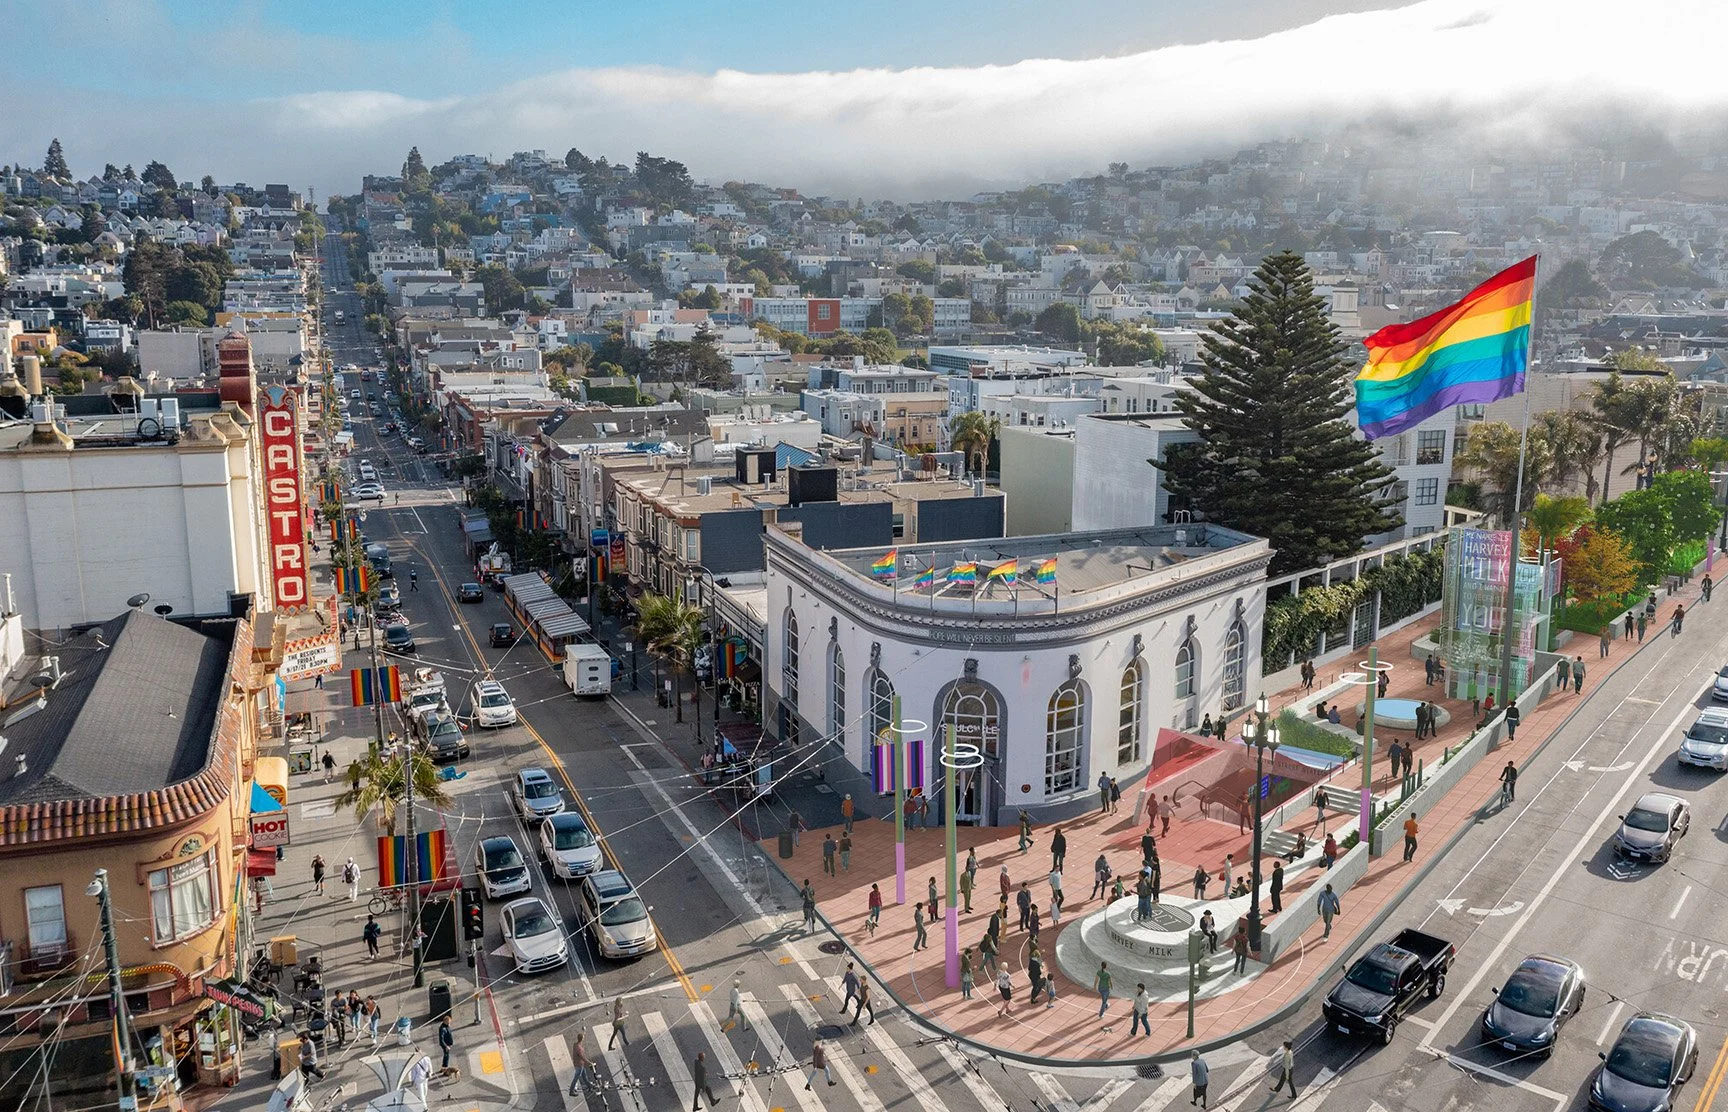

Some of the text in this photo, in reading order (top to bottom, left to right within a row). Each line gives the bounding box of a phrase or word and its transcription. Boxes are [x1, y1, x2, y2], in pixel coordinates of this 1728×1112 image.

[265, 410, 304, 601] CASTRO
[1465, 542, 1508, 557] HARVEY
[1463, 556, 1507, 582] MILK
[1462, 603, 1507, 630] YOU
[929, 630, 1016, 643] HOPE WILL NEVER BE SILENT
[300, 647, 326, 658] RESIDENTS
[297, 656, 316, 665] FRIDAY
[253, 820, 287, 834] HOT
[254, 831, 287, 842] COOKIE
[1111, 931, 1172, 957] HARVEY MILK
